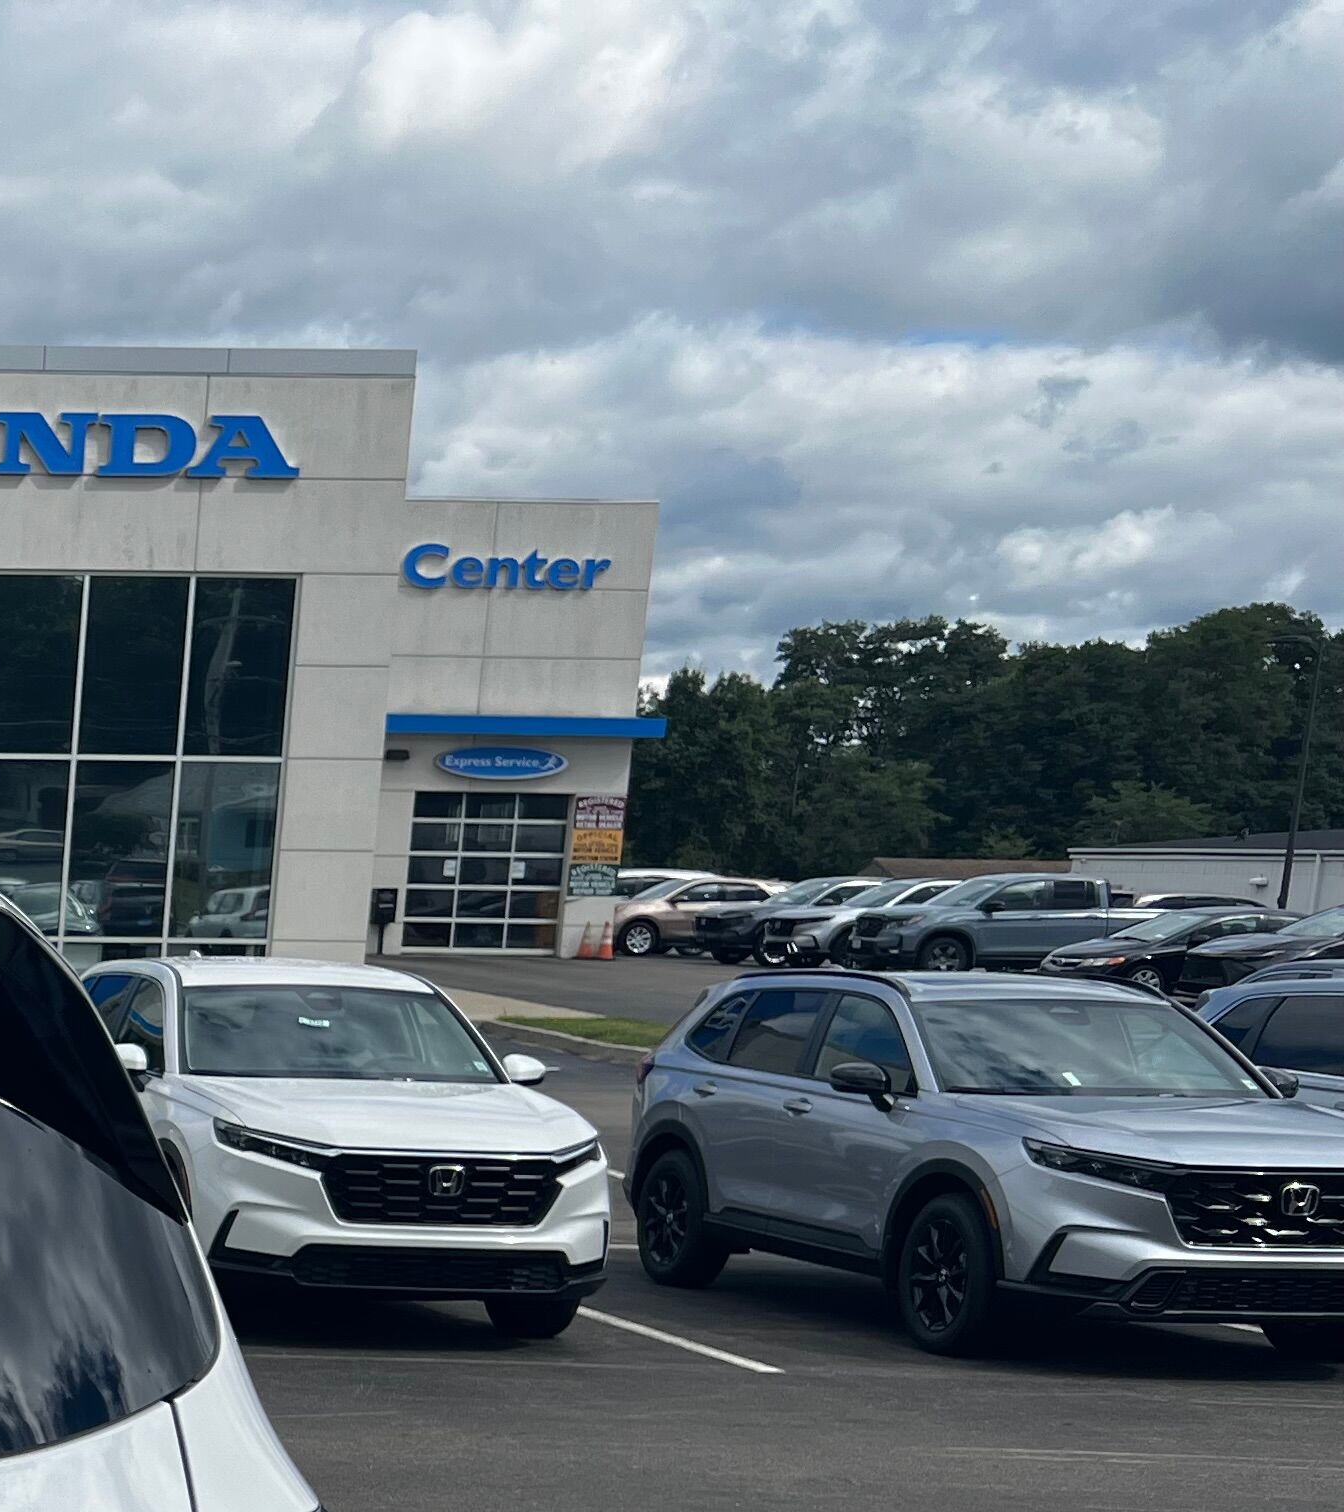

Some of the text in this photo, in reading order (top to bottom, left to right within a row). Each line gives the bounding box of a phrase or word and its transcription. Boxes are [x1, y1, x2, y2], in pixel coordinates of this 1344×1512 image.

[402, 543, 612, 590] Center
[444, 755, 539, 769] Express Service
